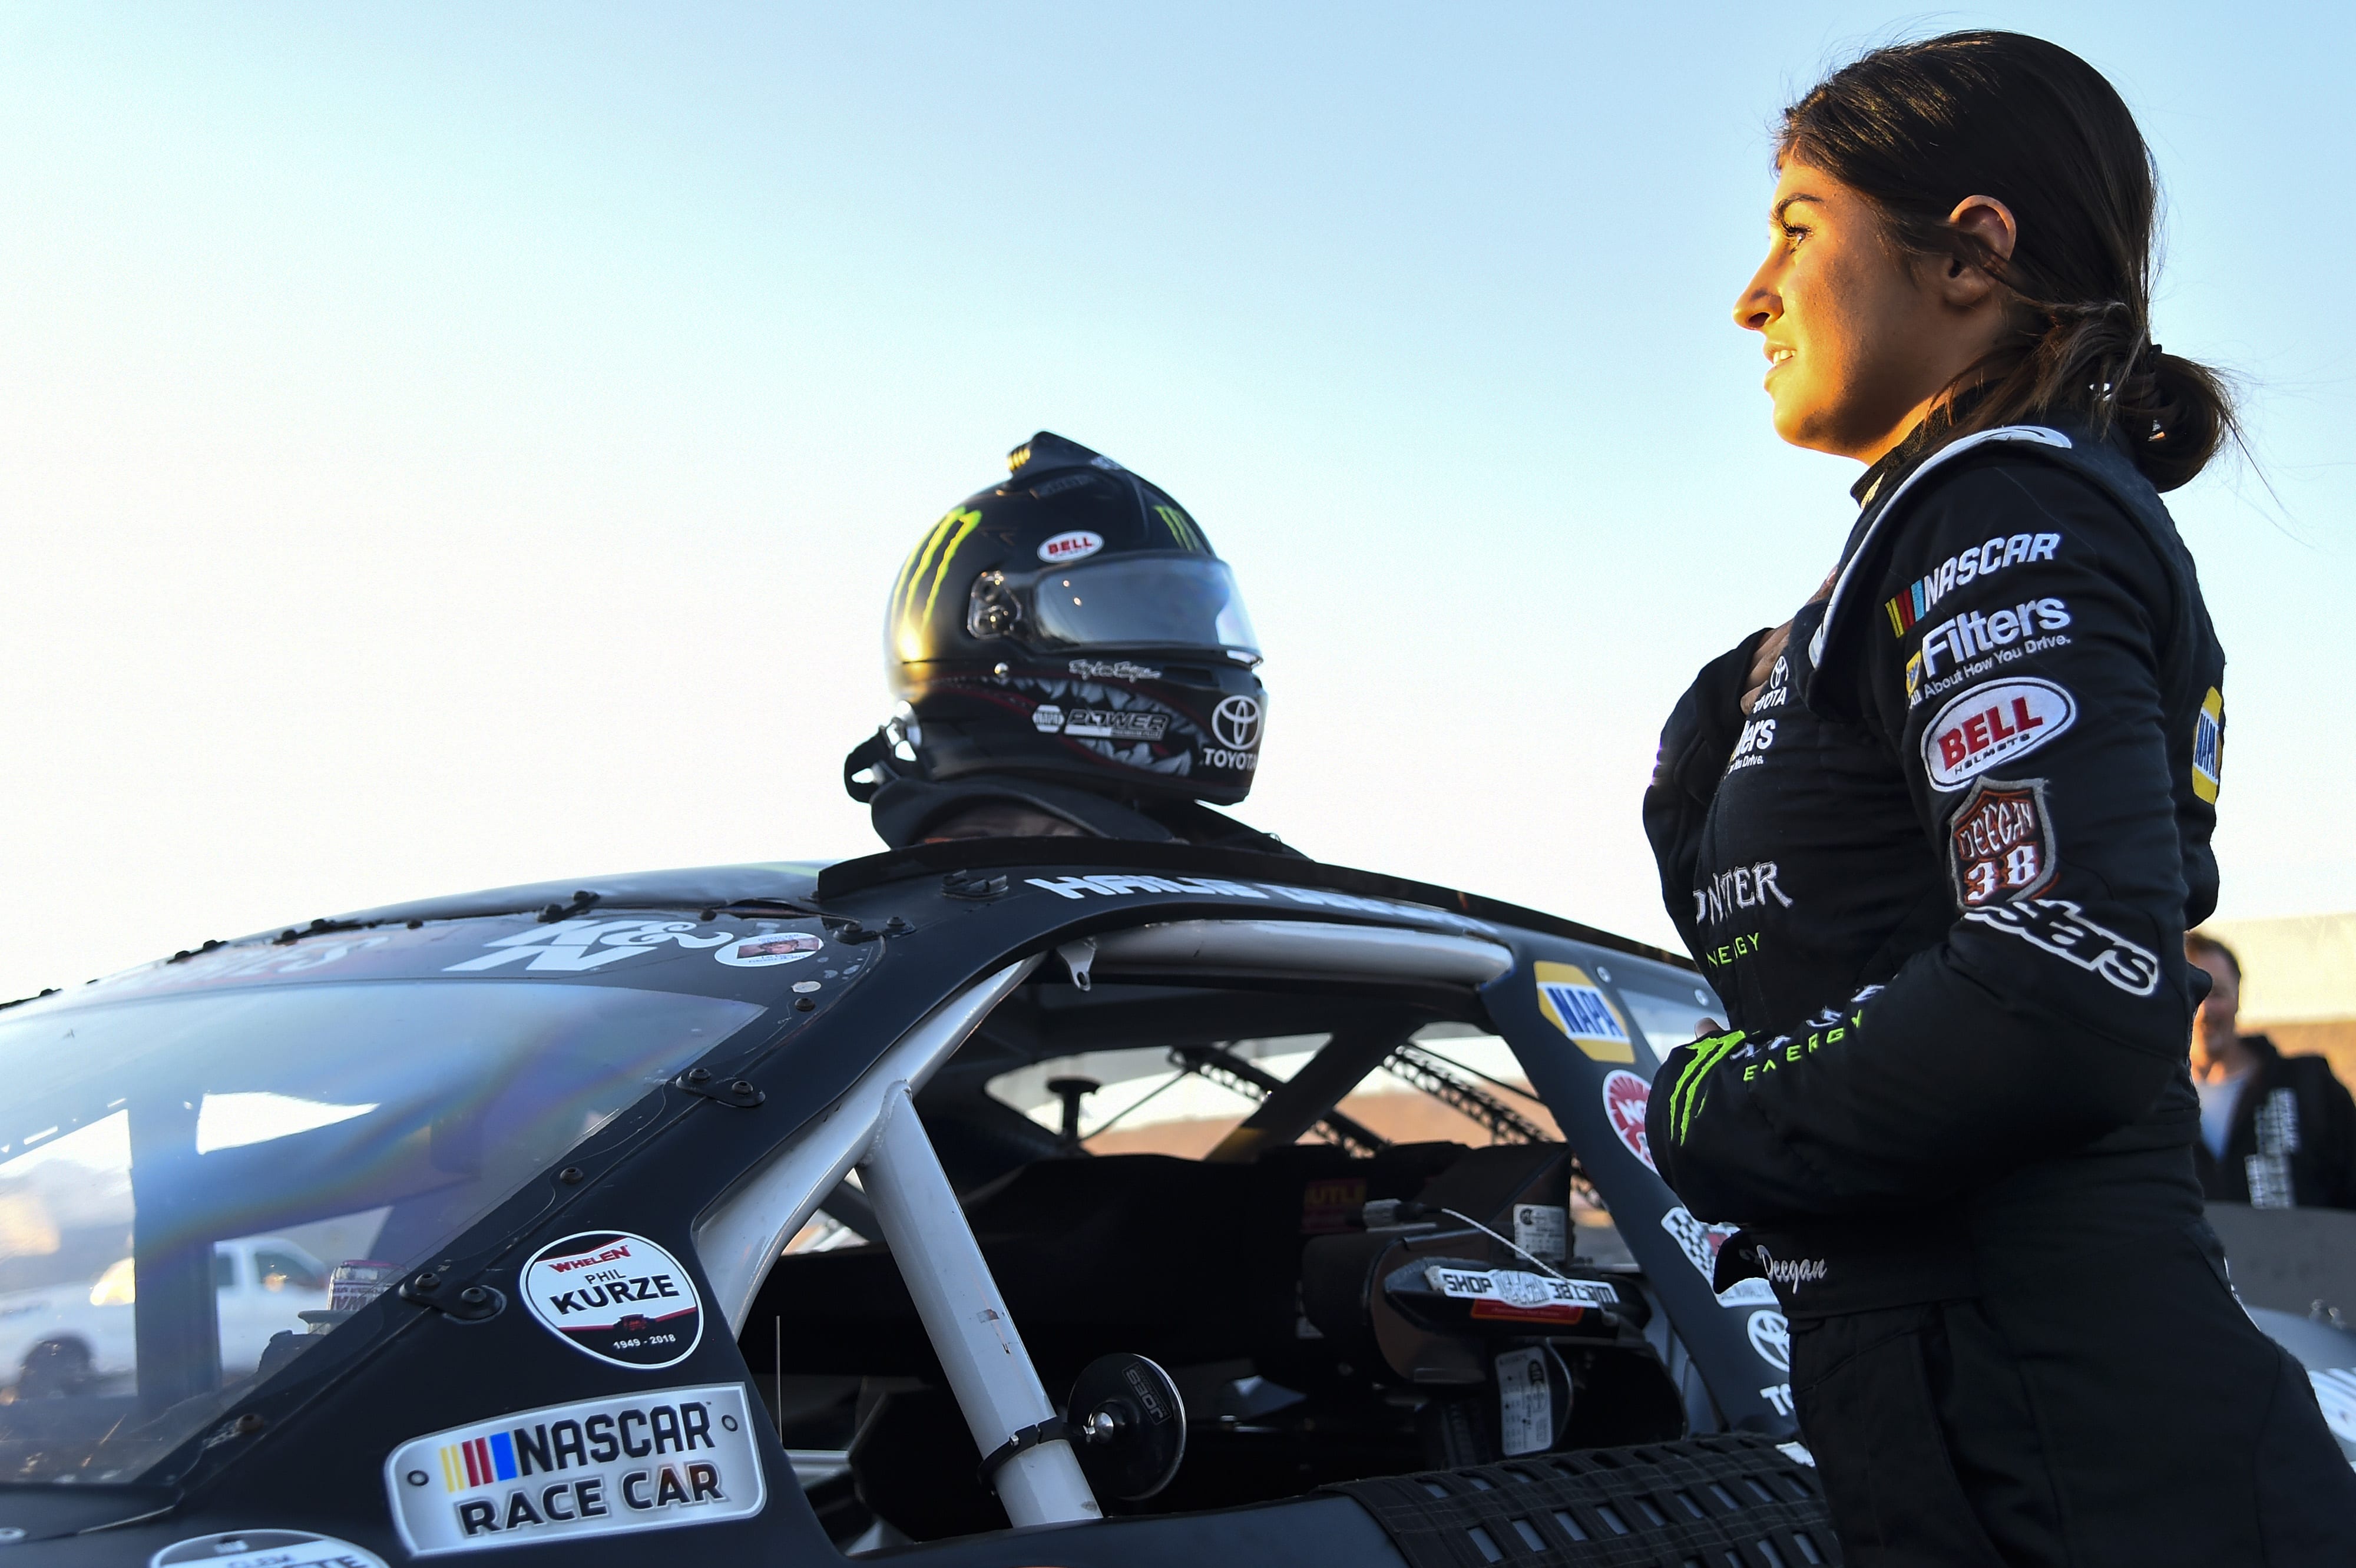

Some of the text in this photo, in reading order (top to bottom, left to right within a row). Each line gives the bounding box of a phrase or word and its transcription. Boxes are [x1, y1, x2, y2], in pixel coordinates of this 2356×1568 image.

[1048, 537, 1093, 554] BELL
[1923, 532, 2061, 613] NASCAR
[1921, 597, 2072, 679] Filters
[1924, 669, 1964, 699] About
[1964, 658, 1993, 678] How
[1993, 647, 2022, 664] You
[2024, 635, 2072, 654] Drive.
[1068, 710, 1167, 731] POWER
[1937, 696, 2044, 772] BELL
[1960, 801, 2034, 859] DEEGAN
[1964, 844, 2039, 904] 38
[1546, 986, 1624, 1037] NAPA
[547, 1244, 631, 1273] WHELEN
[584, 1268, 627, 1285] PHIL
[1443, 1274, 1493, 1294] SHOP
[1756, 1244, 1827, 1294] Deegan
[548, 1274, 680, 1315] KURZE
[613, 1337, 641, 1349] 1949
[650, 1333, 677, 1345] 2018
[1126, 1368, 1164, 1419] JOES
[514, 1401, 715, 1477] NASCAR
[459, 1462, 724, 1537] RACE CAR
